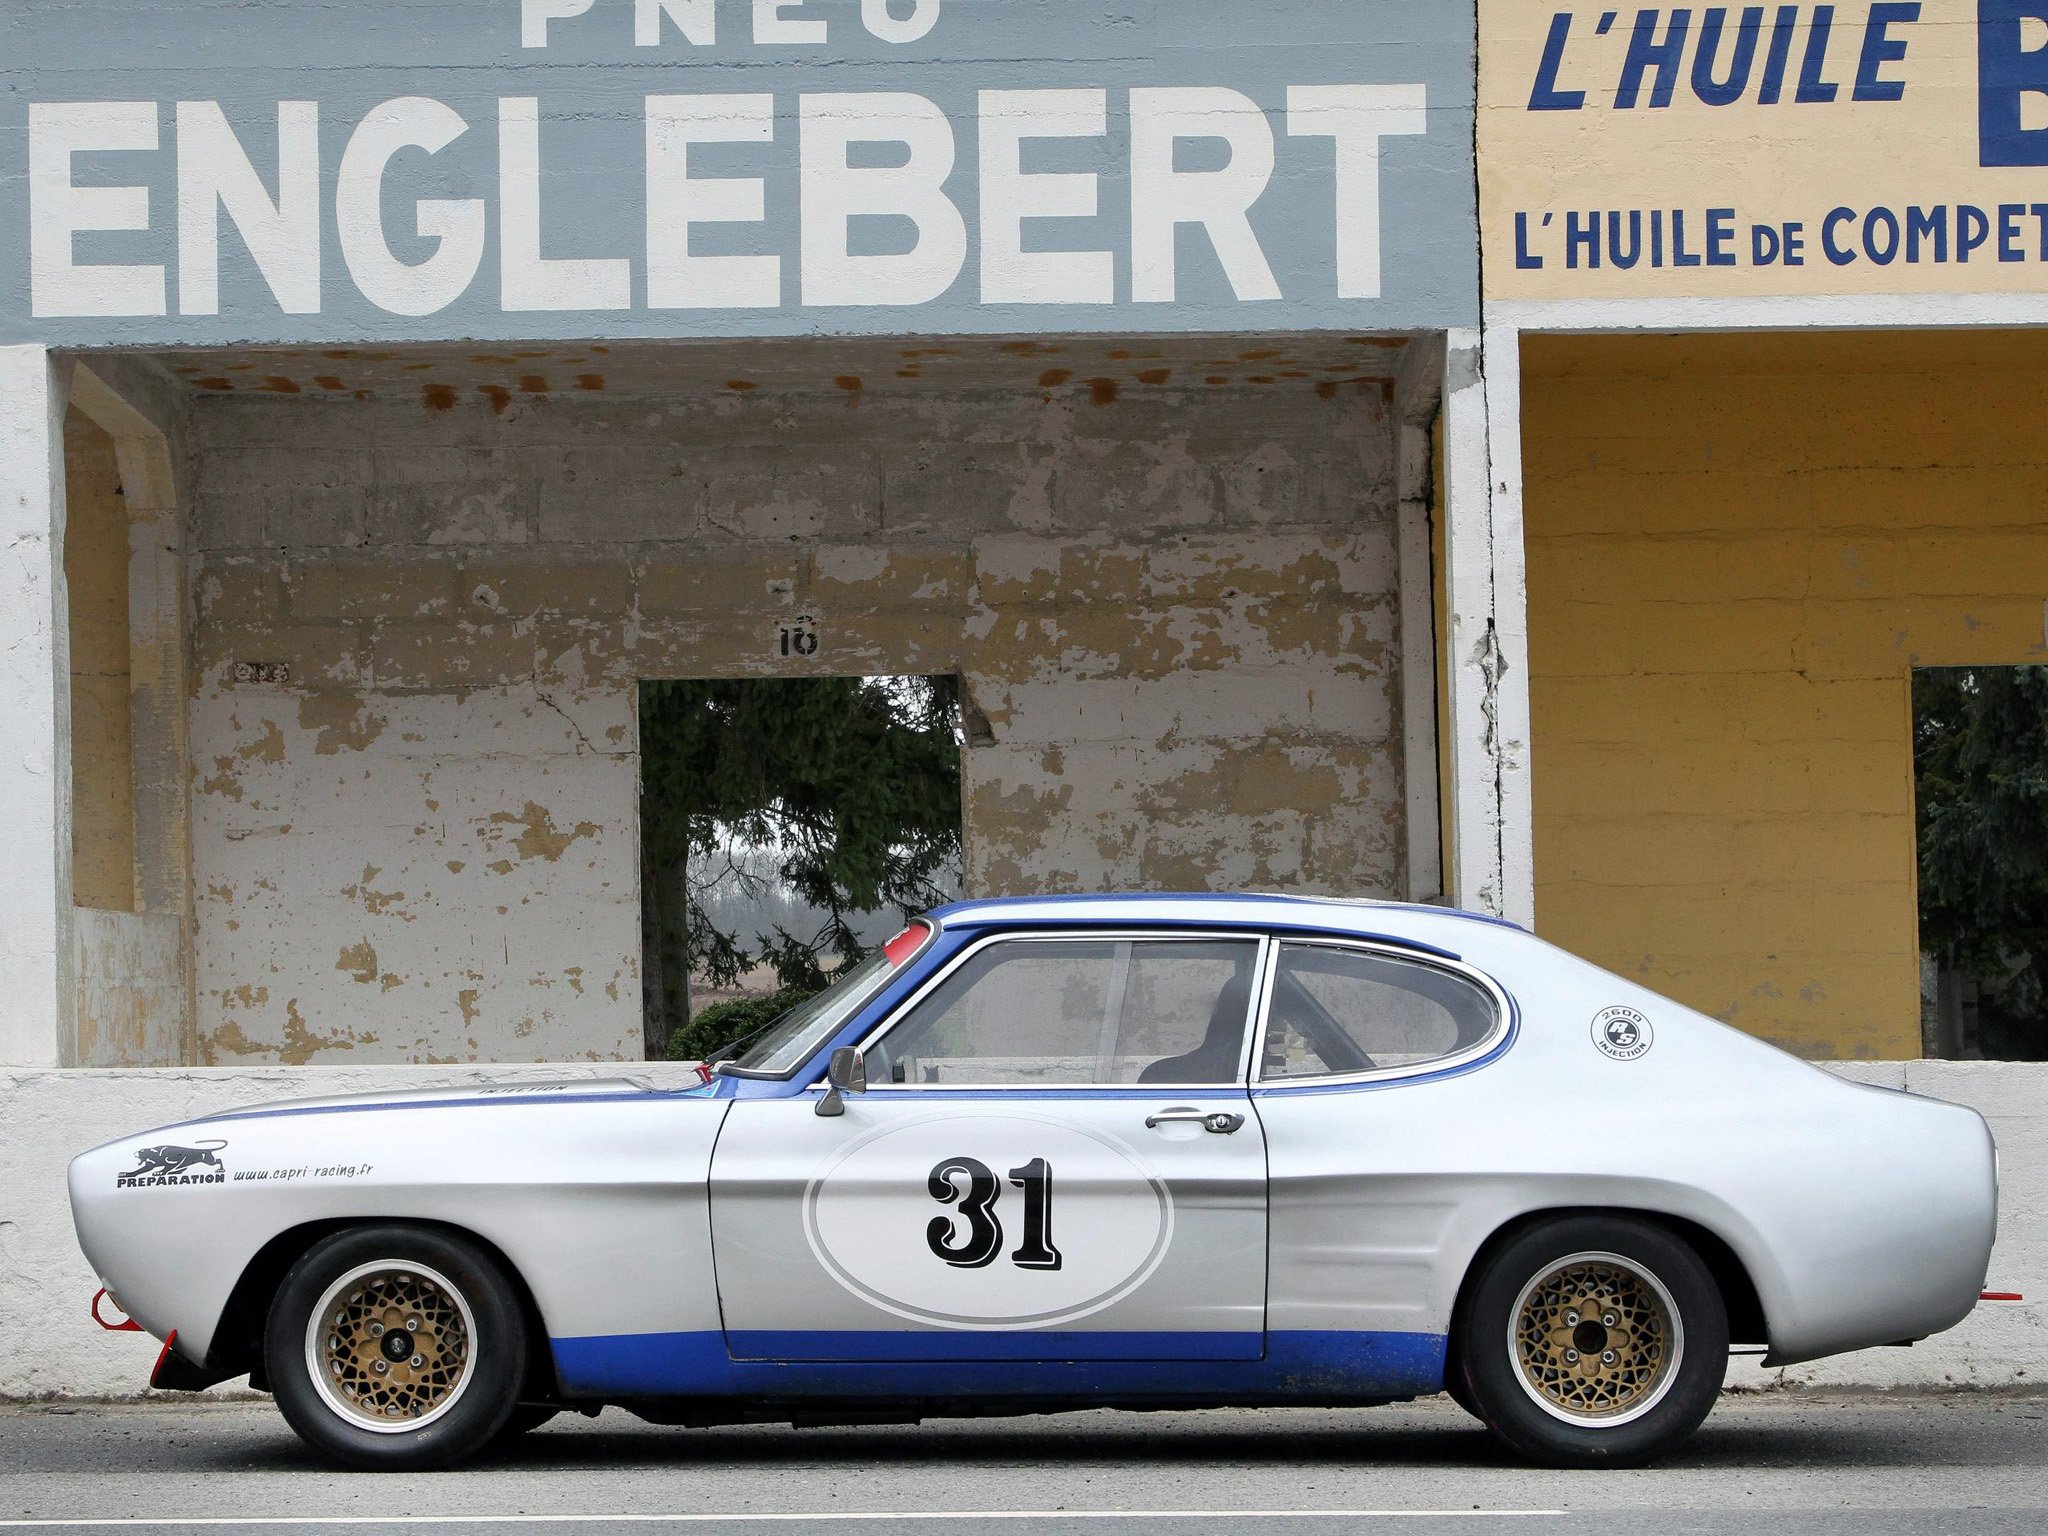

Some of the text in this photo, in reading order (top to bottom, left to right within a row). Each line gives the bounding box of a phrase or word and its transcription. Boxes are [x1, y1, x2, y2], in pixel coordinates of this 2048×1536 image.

[1527, 2, 1921, 111] L'HUILE
[1977, 0, 2048, 167] B
[28, 83, 1427, 318] ENGLEBERT
[1514, 208, 1736, 270] L'HUILE
[1752, 222, 1804, 266] DE
[1598, 1040, 1647, 1058] INJECTION
[1602, 1008, 1642, 1022] 2600
[116, 1163, 374, 1188] PREPARATION www.capri-racing.fr
[926, 1156, 1063, 1271] 31
